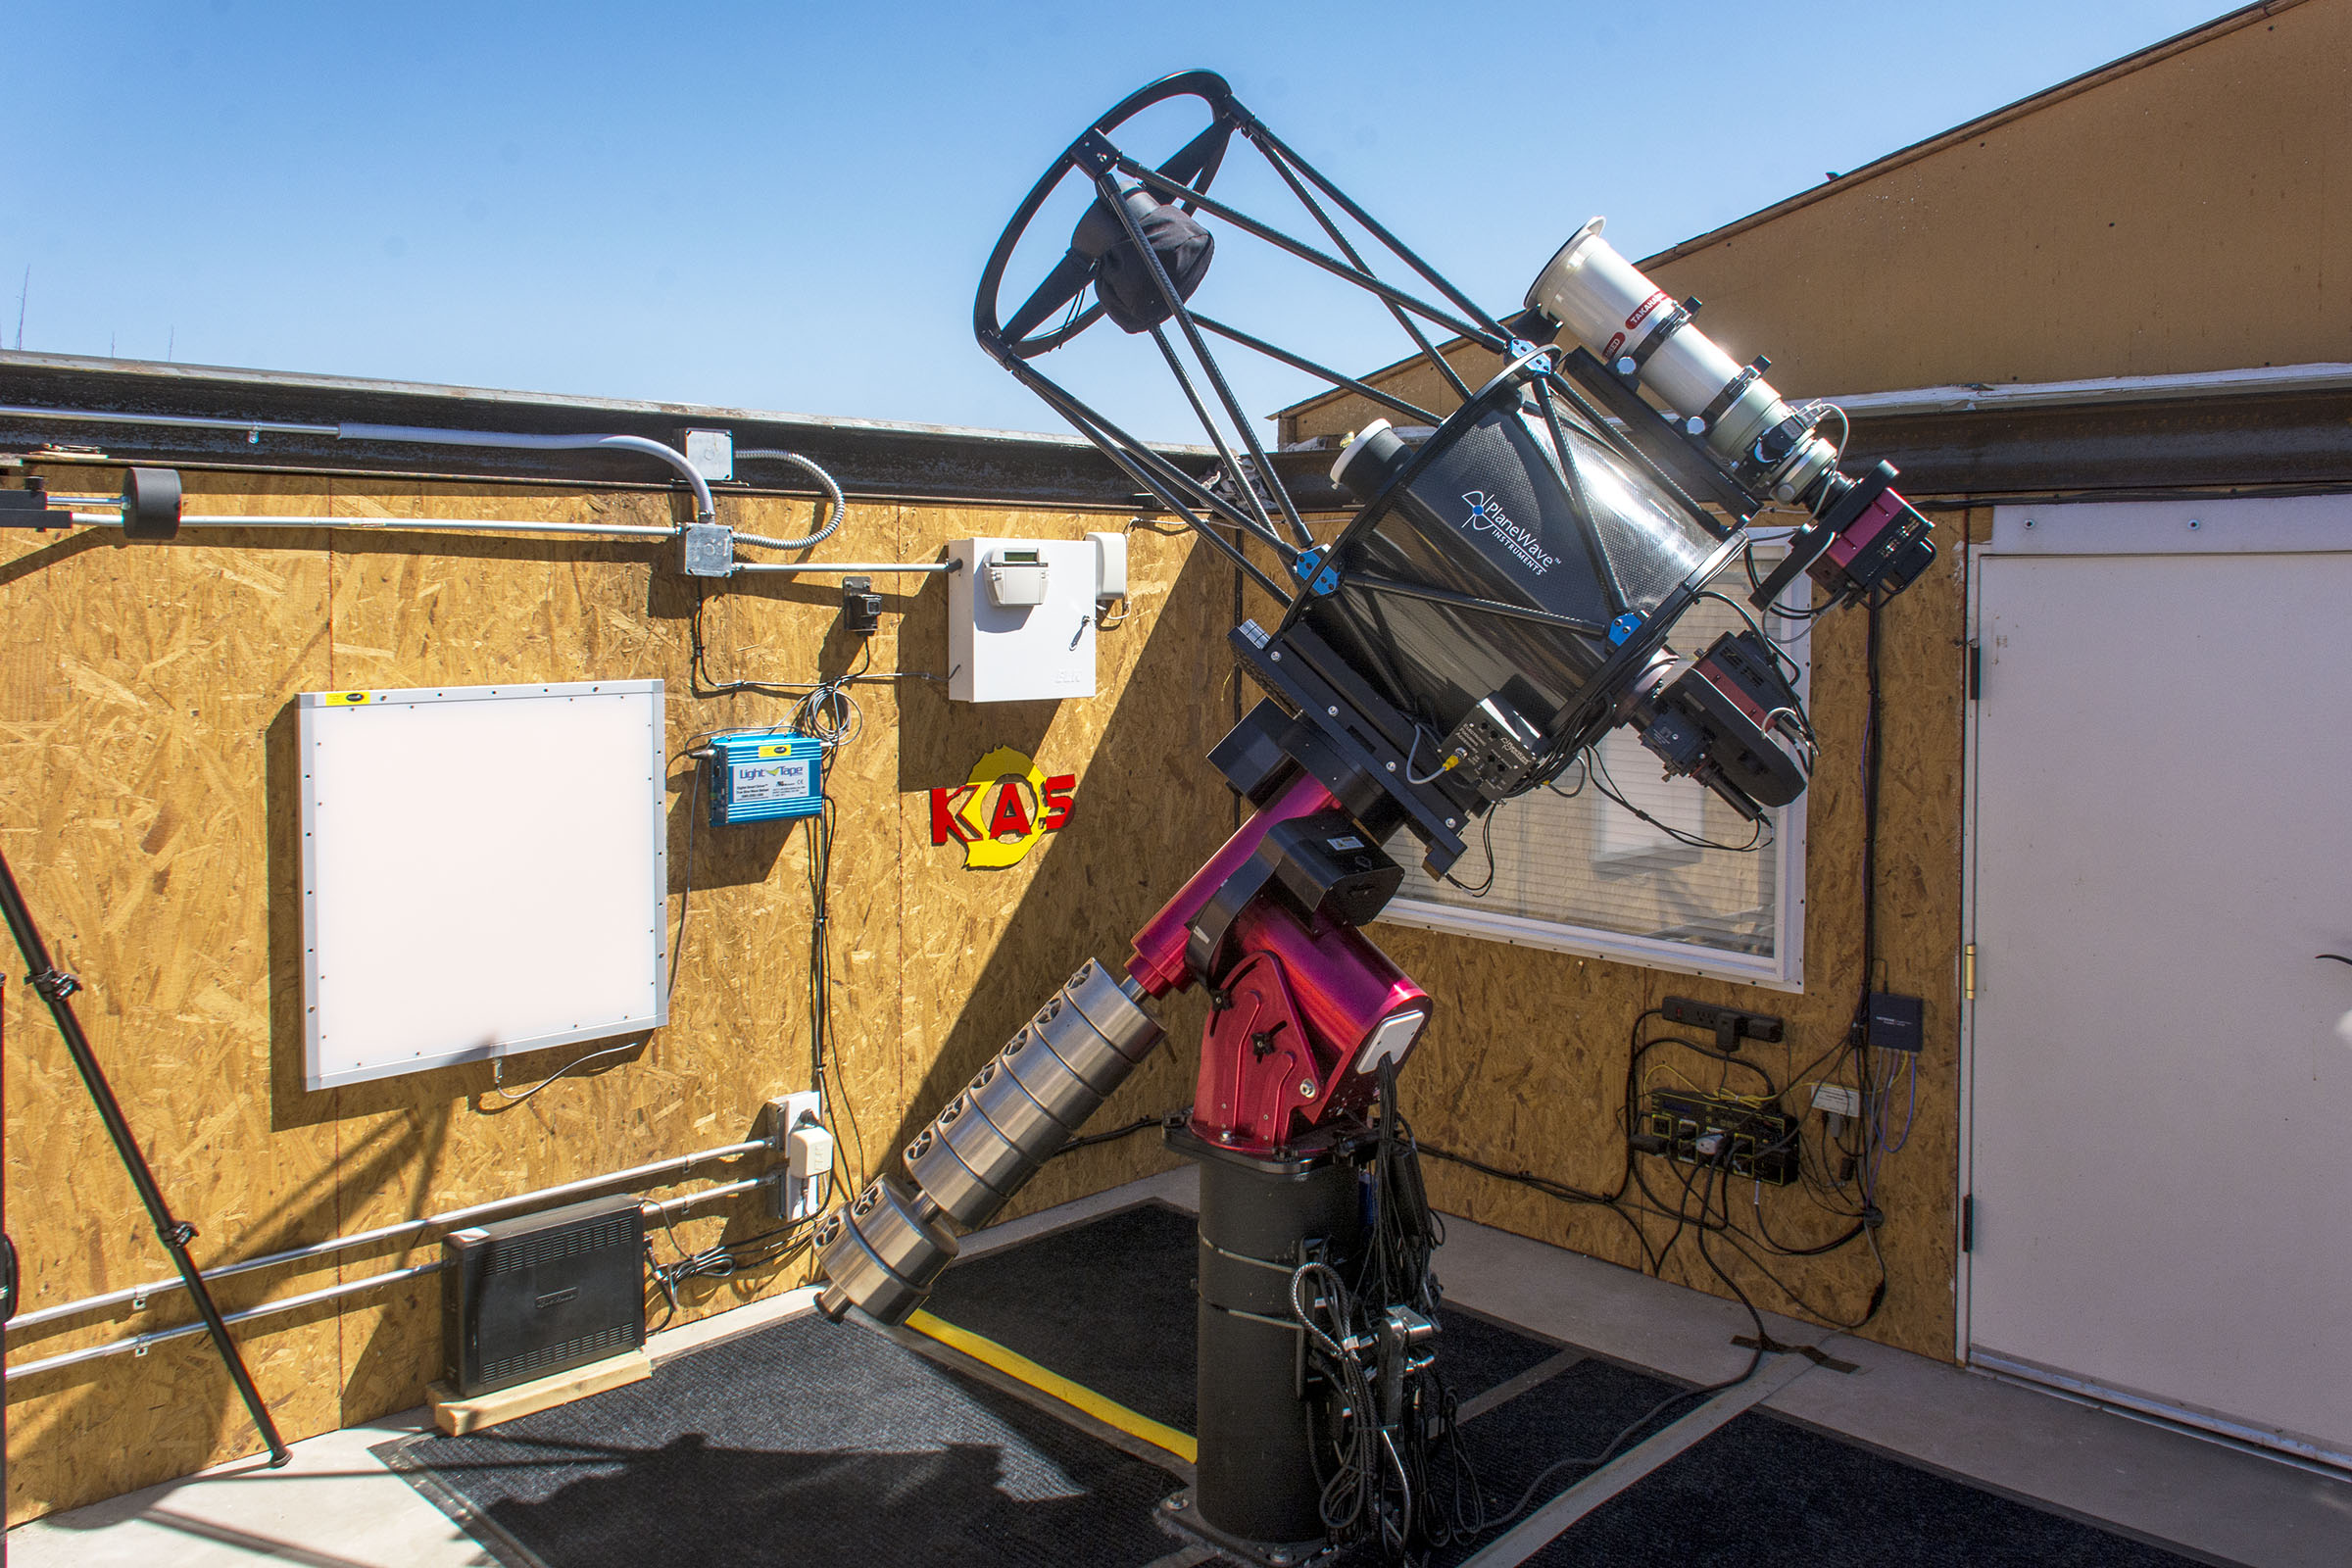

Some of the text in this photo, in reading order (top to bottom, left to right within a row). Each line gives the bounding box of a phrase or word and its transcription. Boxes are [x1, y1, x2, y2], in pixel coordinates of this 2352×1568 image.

[1492, 529, 1544, 576] INSTRUMENTS
[739, 765, 804, 781] Light Tape
[931, 774, 1075, 844] KAS
